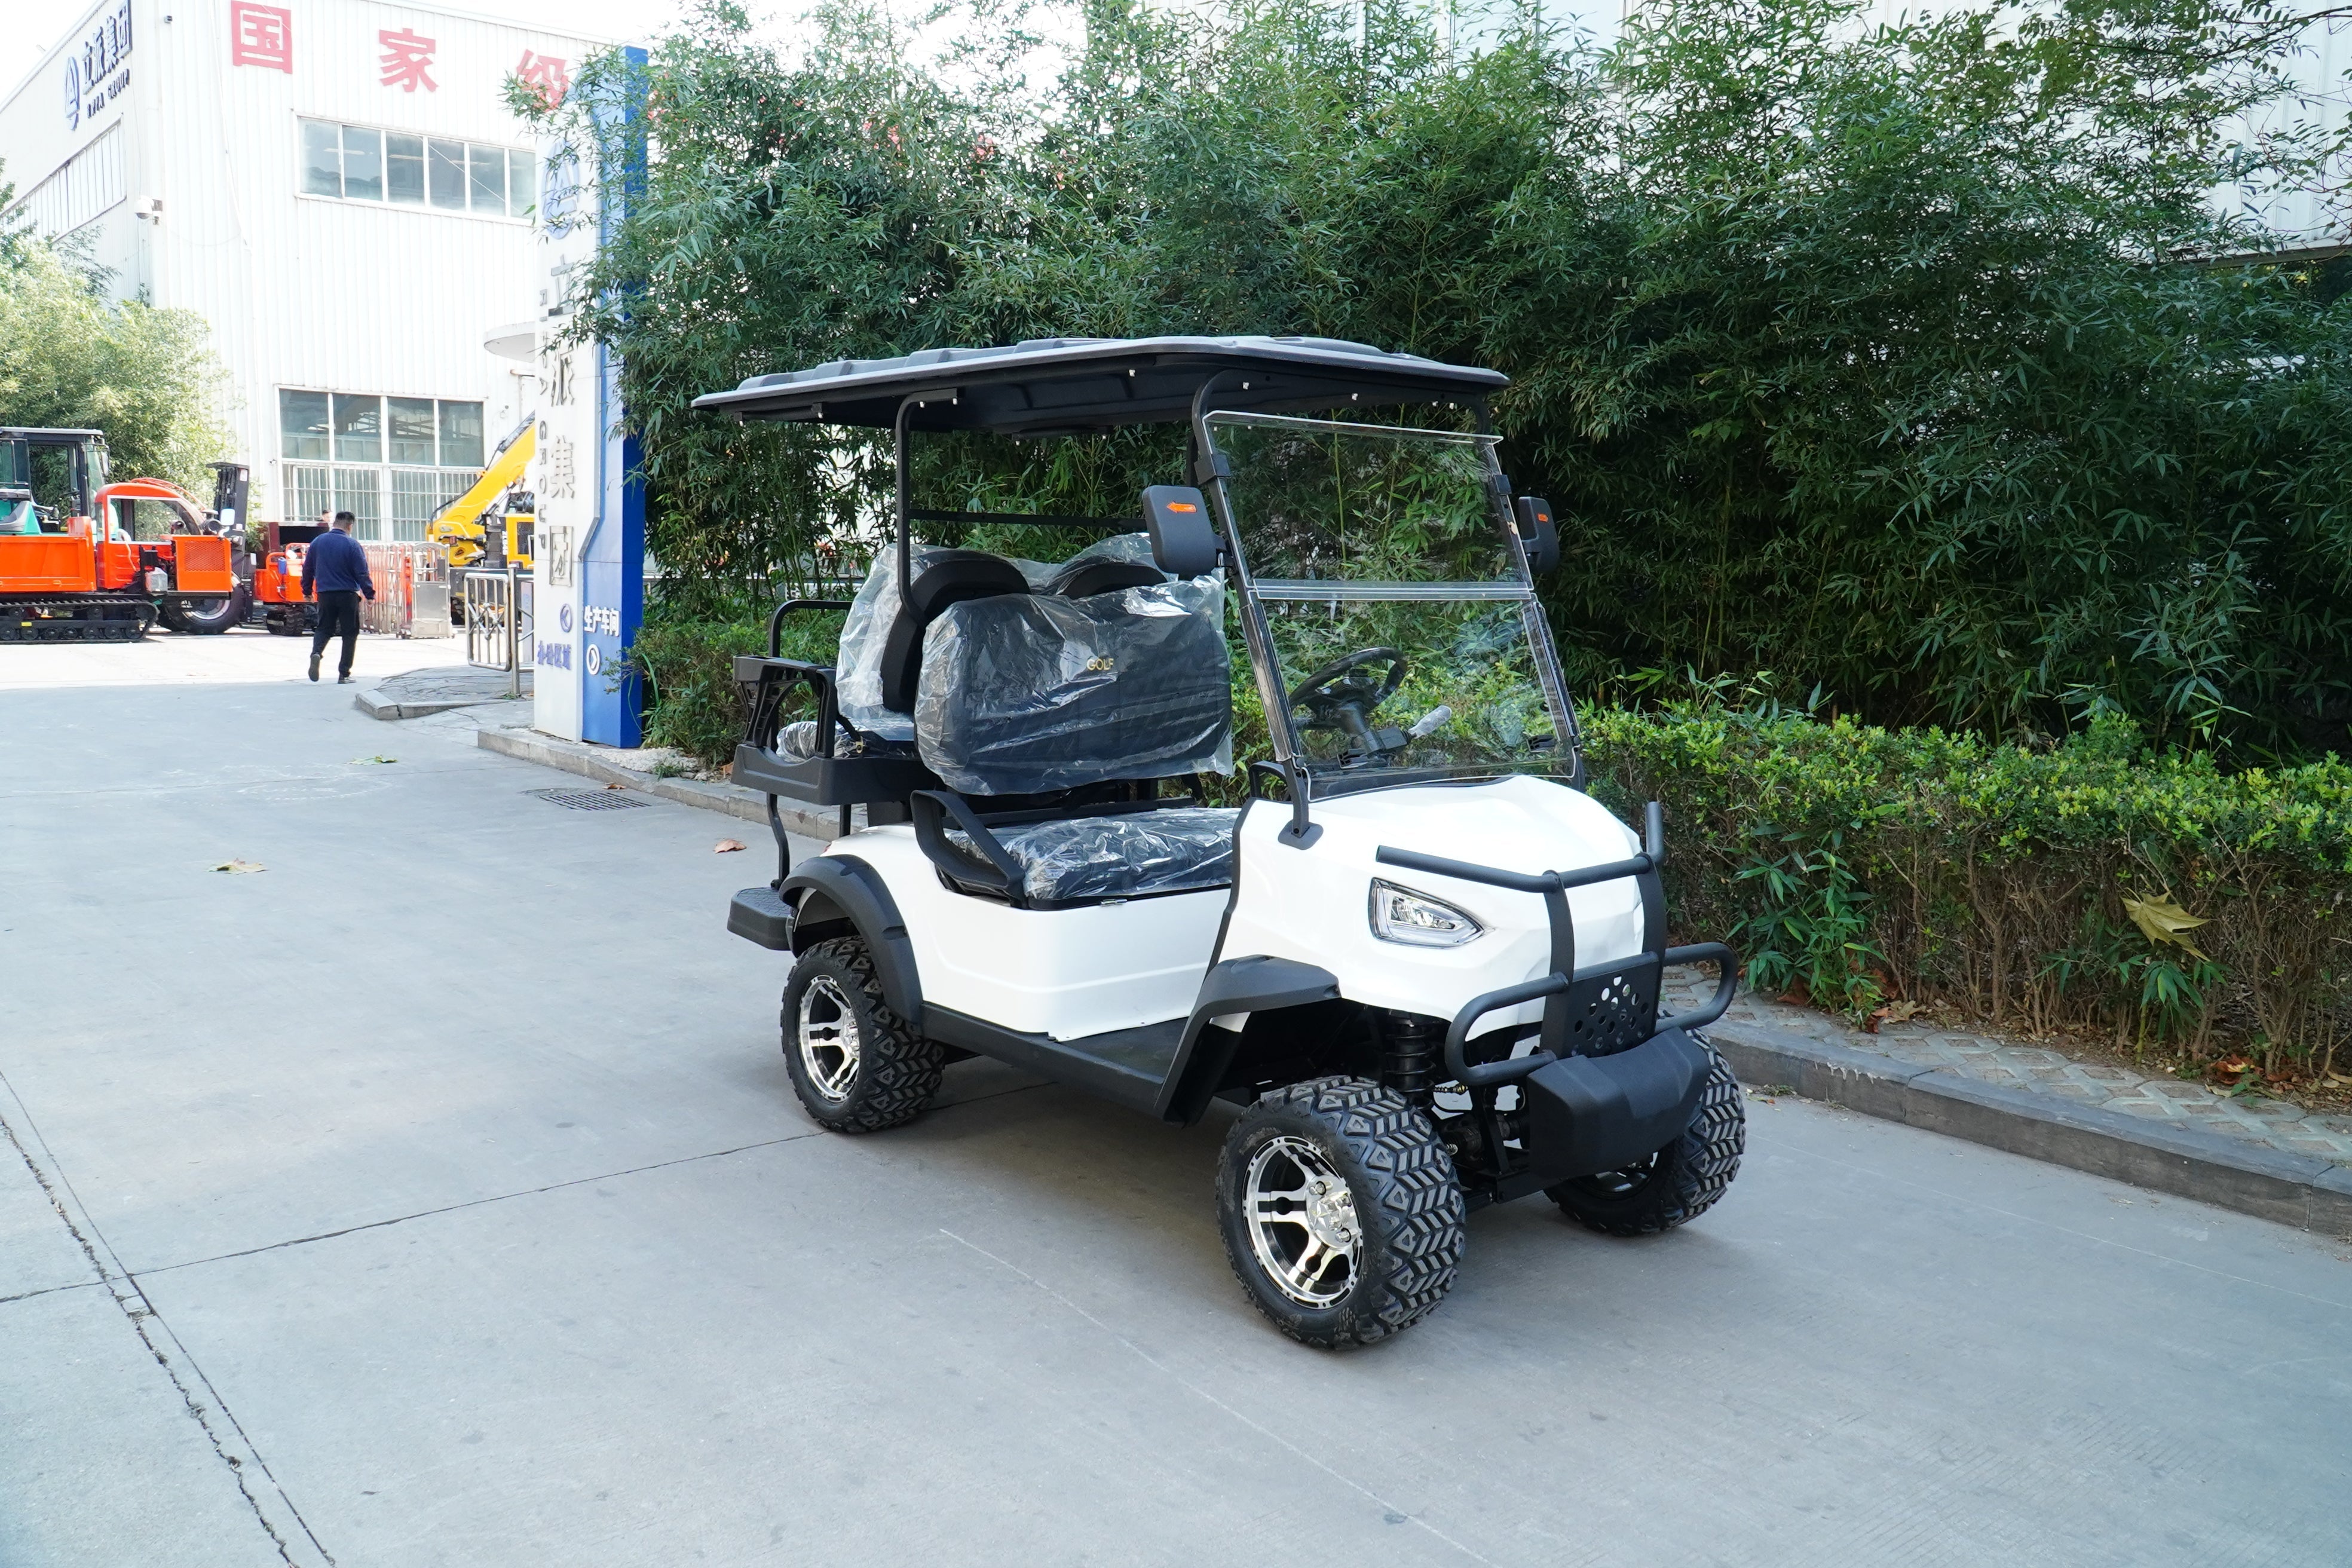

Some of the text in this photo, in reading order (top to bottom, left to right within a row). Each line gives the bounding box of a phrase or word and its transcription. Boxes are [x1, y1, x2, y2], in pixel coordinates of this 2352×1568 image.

[538, 419, 548, 549] GROUP
[584, 605, 620, 636] 生产车间
[1086, 657, 1114, 670] GOLF
